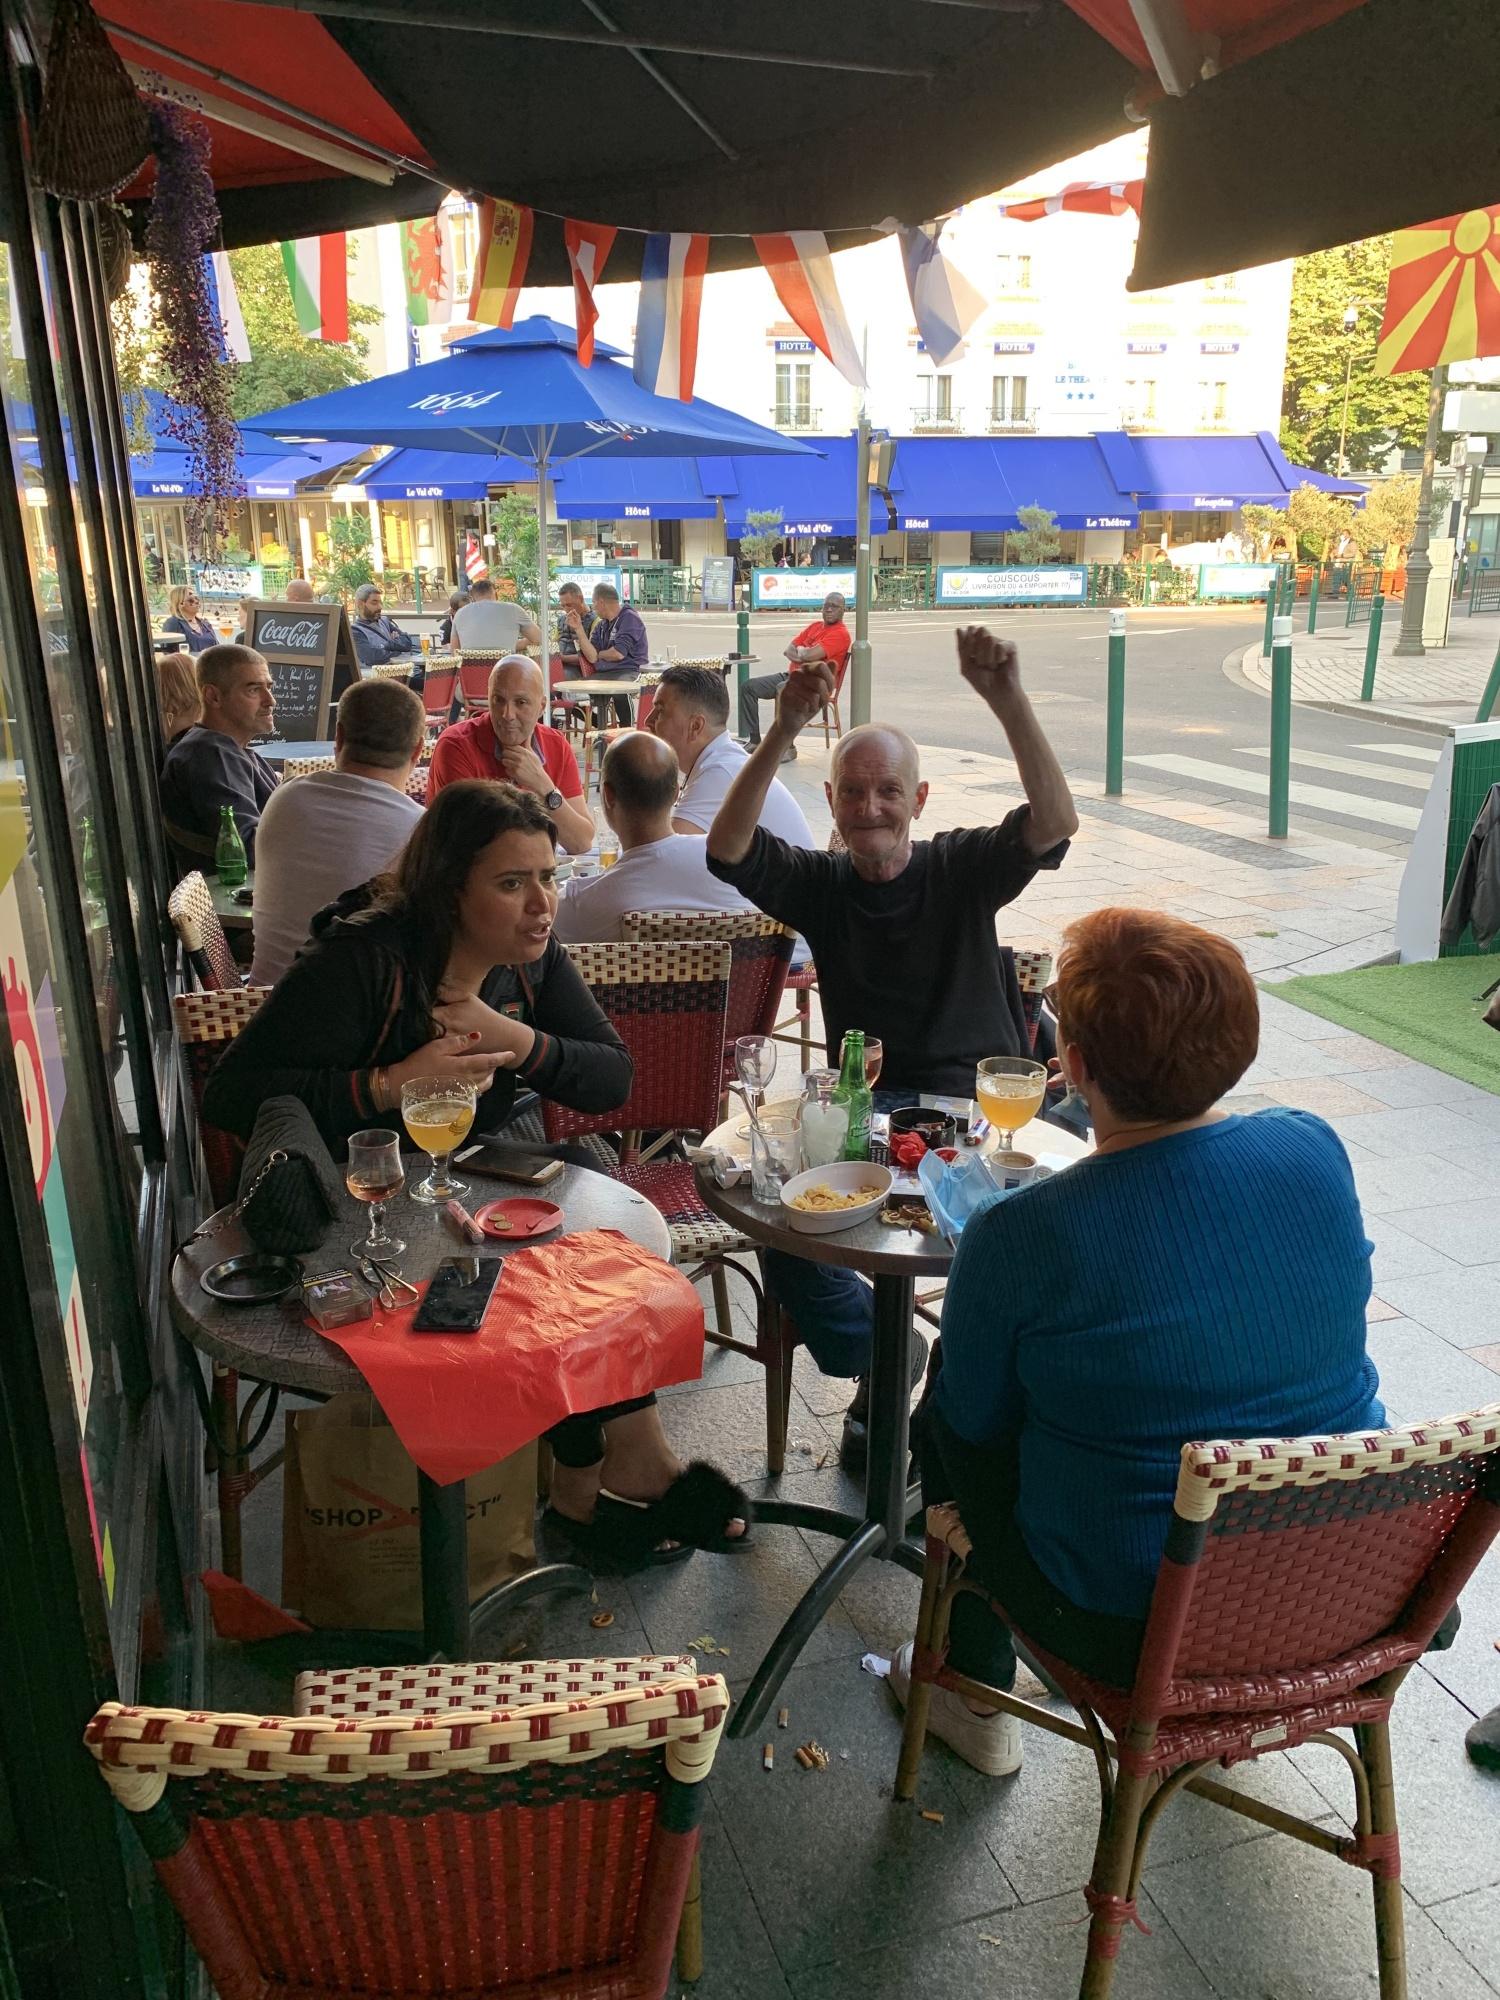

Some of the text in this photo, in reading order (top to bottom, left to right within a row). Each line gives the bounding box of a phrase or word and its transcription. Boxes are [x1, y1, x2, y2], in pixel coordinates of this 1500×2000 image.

[779, 342, 812, 351] HOTEL
[1000, 343, 1029, 351] HOTEL
[407, 391, 503, 410] 1664
[406, 487, 443, 496] Le Val d'Or
[624, 506, 650, 516] Hôtel
[905, 519, 929, 529] Hôtel
[1086, 517, 1131, 527] Le Théâtre
[784, 523, 833, 534] Le Val d'Or
[987, 574, 1040, 583] COUSCOUS
[1024, 582, 1059, 590] EMPORTER
[259, 619, 323, 649] Coca-Cola
